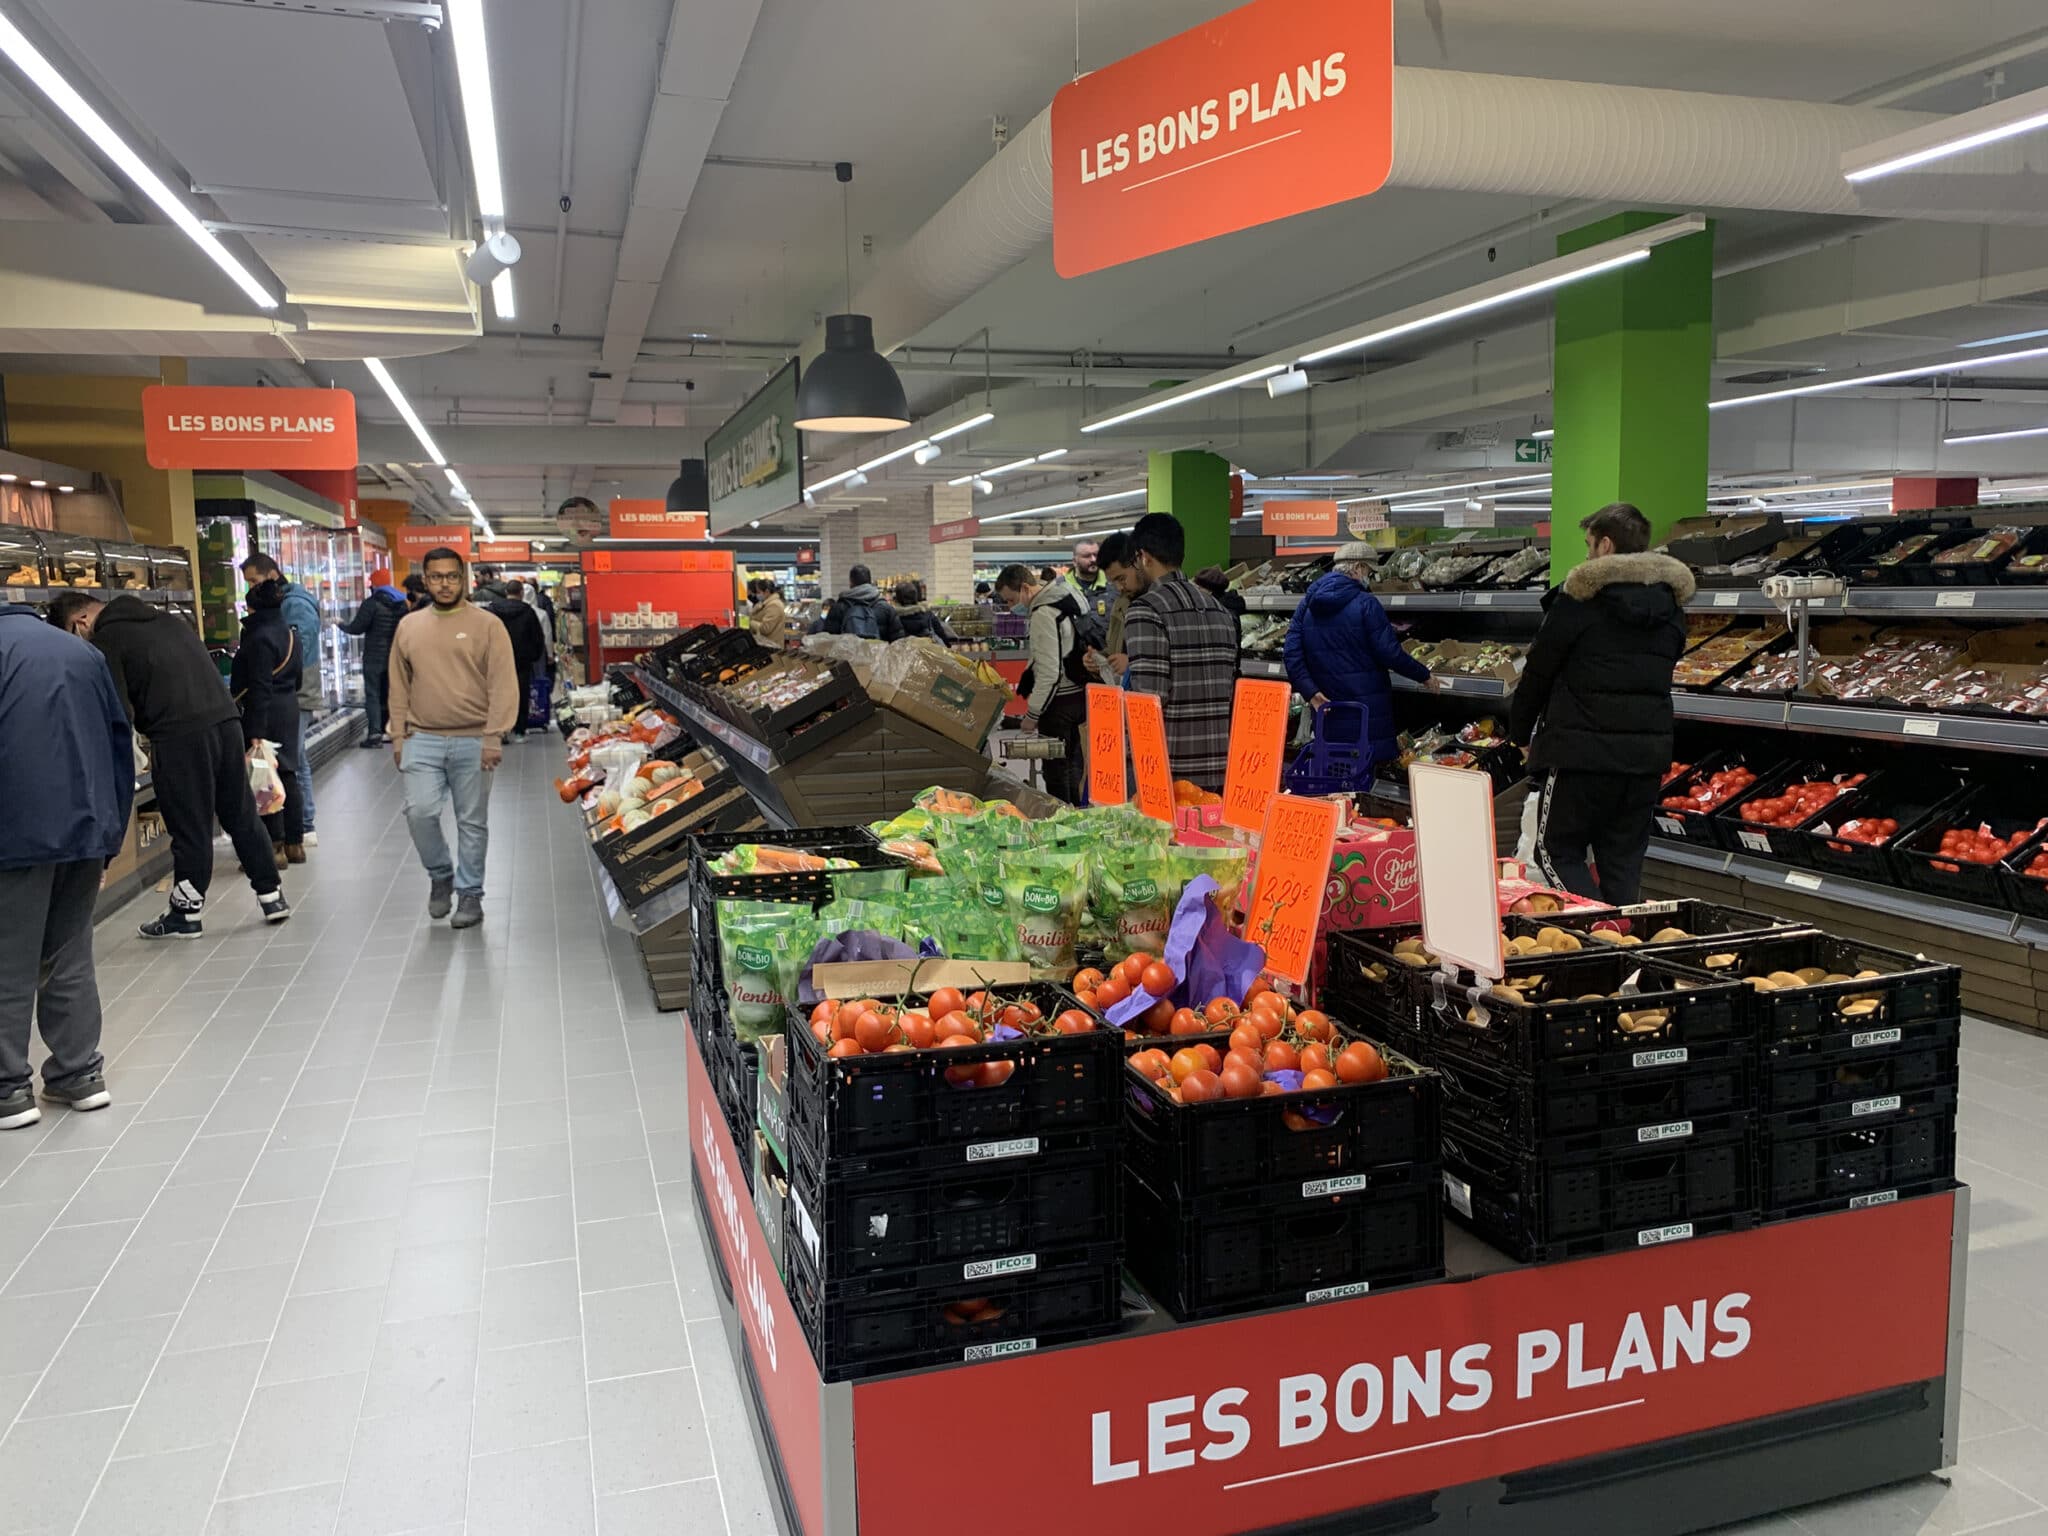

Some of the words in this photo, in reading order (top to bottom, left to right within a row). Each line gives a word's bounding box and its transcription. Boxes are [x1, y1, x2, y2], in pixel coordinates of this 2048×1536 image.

[1081, 133, 1129, 184] LES
[1138, 100, 1219, 163] BONS
[1229, 52, 1347, 131] PLANS
[168, 415, 206, 431] LES
[211, 416, 265, 432] BONS
[270, 416, 335, 433] PLANS
[620, 513, 637, 522] LES
[639, 513, 664, 522] BONS
[666, 513, 696, 522] PLANS
[1270, 512, 1285, 521] LES
[1286, 512, 1304, 521] BONS
[1306, 513, 1330, 521] PLANS
[404, 535, 418, 544] LES
[440, 535, 463, 544] PLANS
[1230, 784, 1269, 814] FRANCE
[1389, 868, 1417, 893] Lad
[1025, 891, 1041, 904] BON
[1045, 894, 1058, 905] BIO
[737, 950, 752, 963] BON
[756, 953, 770, 965] BIO
[1873, 1030, 1891, 1041] IFCO
[1656, 1050, 1677, 1060] IFCO
[1872, 1098, 1890, 1108] IFCO
[1661, 1123, 1681, 1134] IFCO
[997, 1141, 1023, 1153] IFCO
[1329, 1177, 1353, 1189] IFCO
[1870, 1192, 1890, 1204] IFCO
[1663, 1225, 1682, 1237] IFCO
[995, 1256, 1022, 1269] IFCO
[1334, 1285, 1356, 1297] IFCO
[995, 1342, 1021, 1354] IFCO
[1092, 1386, 1250, 1485] LES
[1279, 1343, 1492, 1448] BONS
[1516, 1292, 1751, 1400] PLANS
